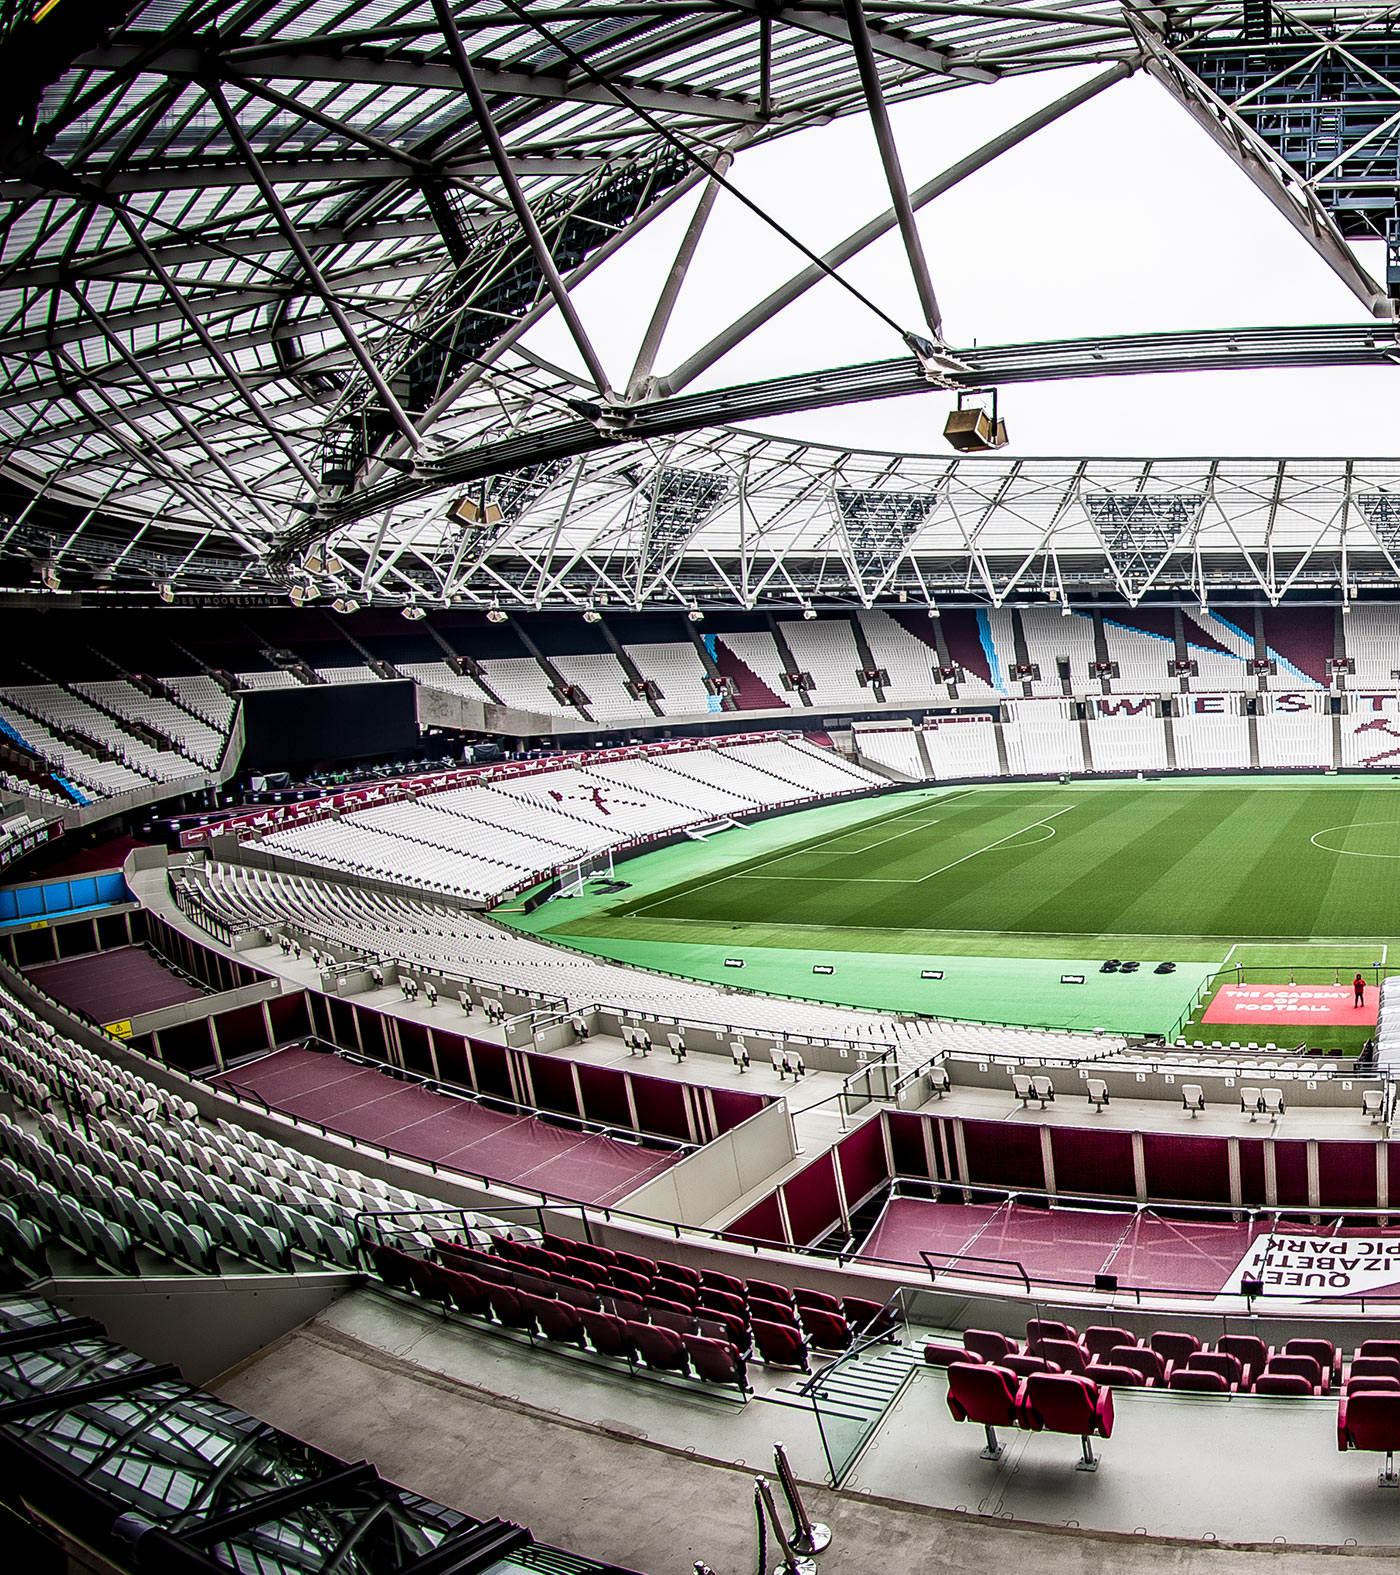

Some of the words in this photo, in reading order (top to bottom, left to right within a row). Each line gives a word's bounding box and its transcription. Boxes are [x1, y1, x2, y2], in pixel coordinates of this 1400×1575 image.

[204, 597, 242, 605] MOORE
[244, 597, 279, 605] STAND
[1091, 694, 1397, 717] WEST
[1262, 991, 1351, 999] ACADEMY
[1234, 1003, 1331, 1011] FOOTBALL
[1265, 1238, 1348, 1255] PARK
